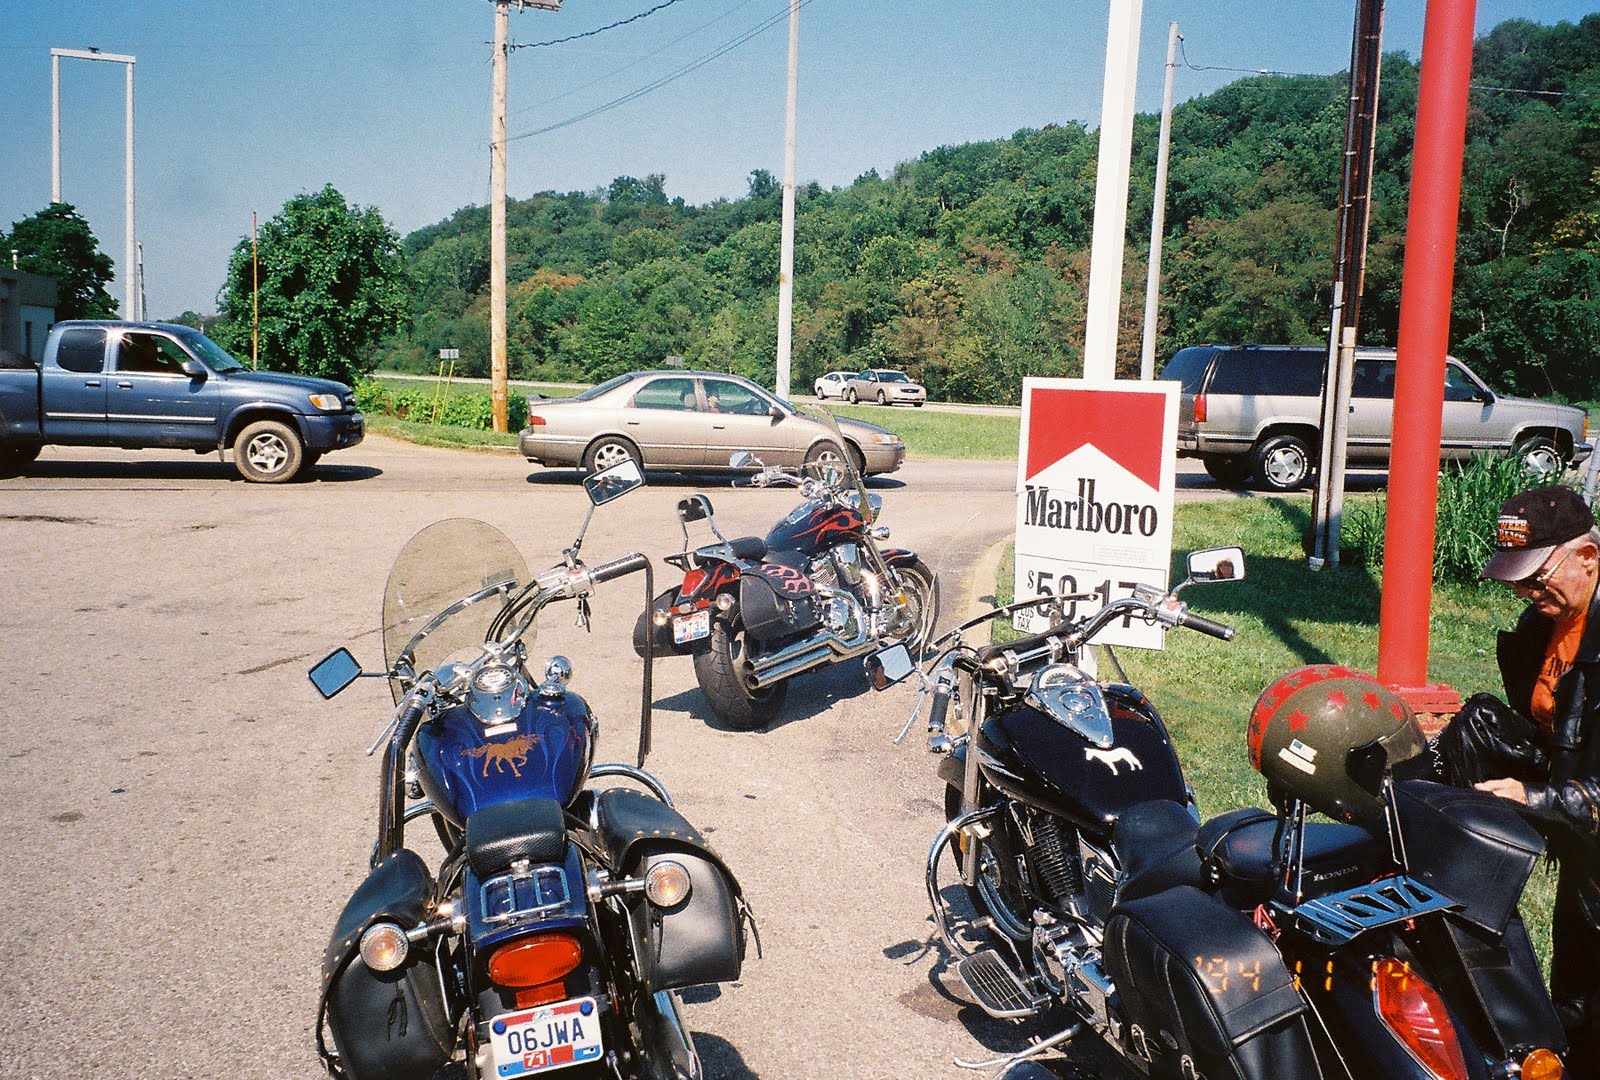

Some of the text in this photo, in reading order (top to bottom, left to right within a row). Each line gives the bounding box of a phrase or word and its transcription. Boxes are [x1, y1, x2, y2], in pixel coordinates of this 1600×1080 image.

[1024, 478, 1158, 537] Marlboro
[1016, 606, 1034, 618] LUS
[1017, 616, 1031, 631] TAX
[1313, 865, 1359, 882] HONDA
[507, 1017, 585, 1055] 06JWA
